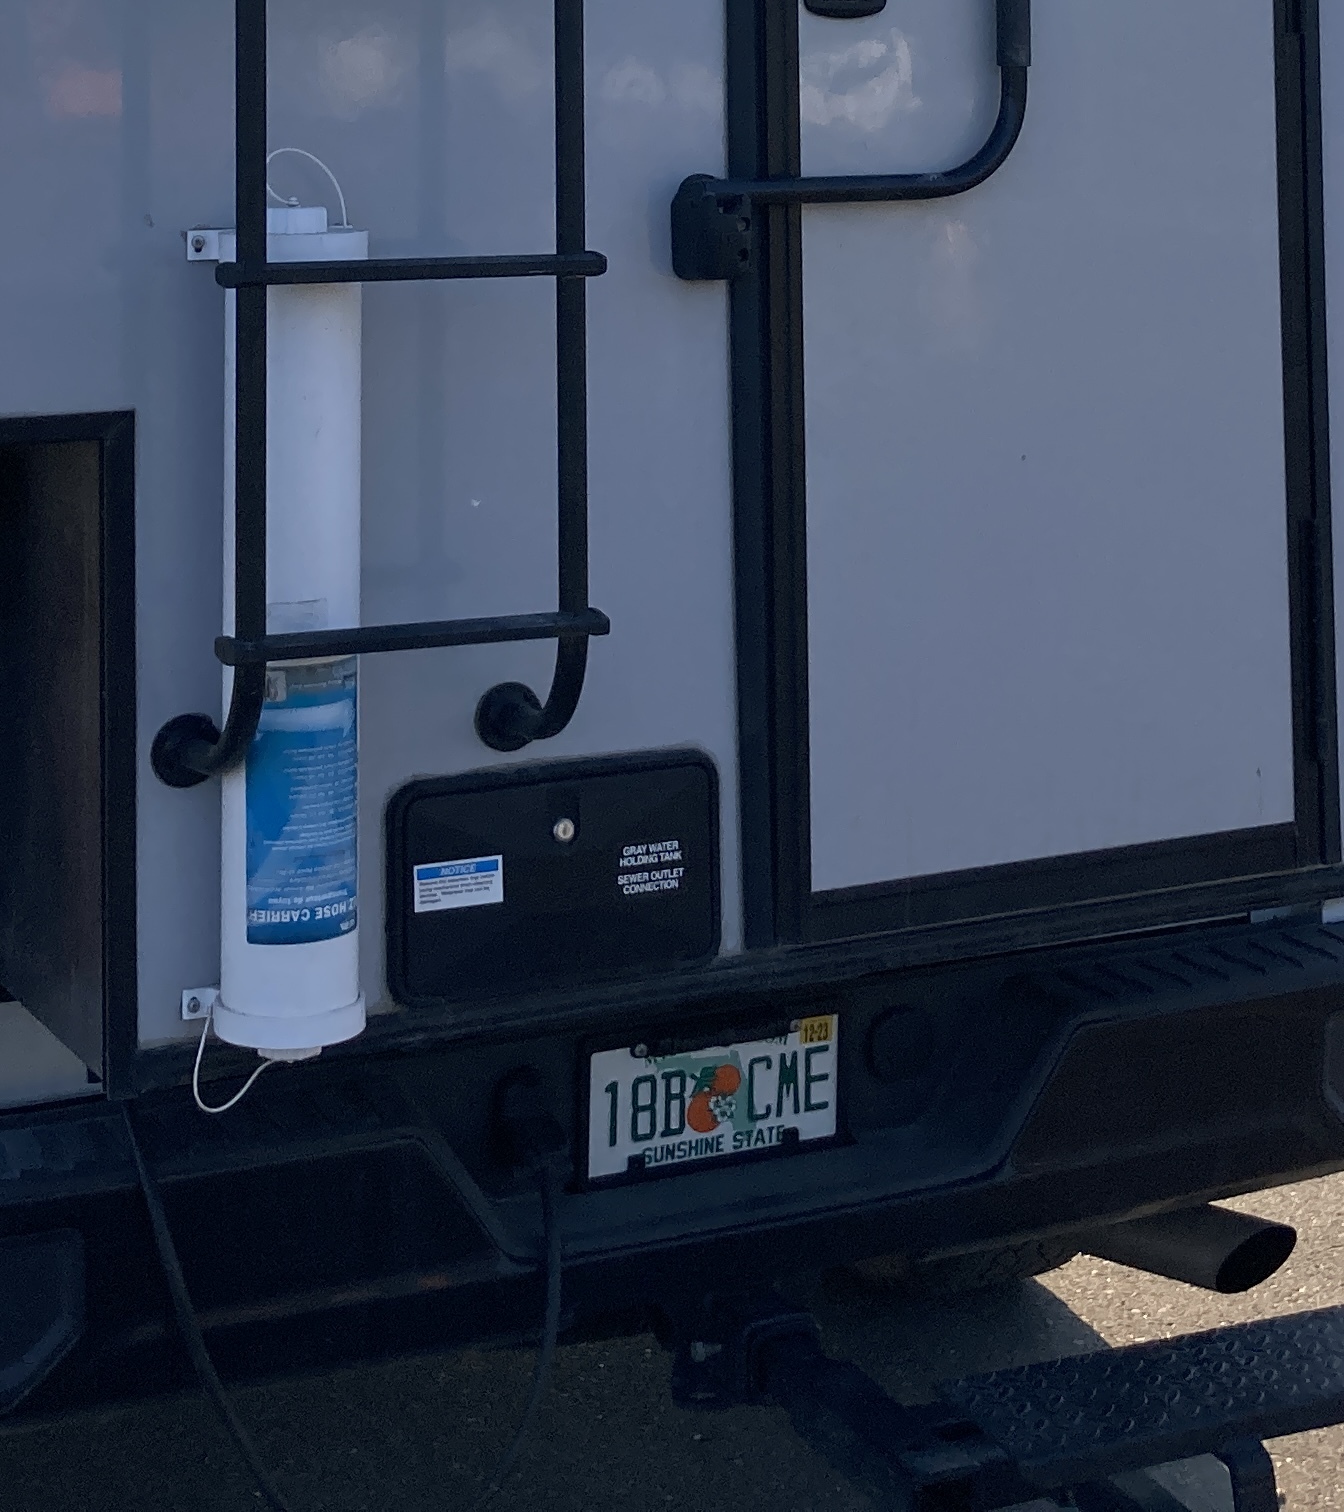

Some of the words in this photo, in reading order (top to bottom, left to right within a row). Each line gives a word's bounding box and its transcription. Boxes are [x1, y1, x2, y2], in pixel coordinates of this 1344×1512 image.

[622, 845, 647, 857] GRAY
[648, 840, 680, 853] WATER
[619, 853, 659, 868] HOLDING
[659, 850, 683, 863] TANK
[440, 863, 477, 876] NOTICE
[617, 871, 649, 886] SEWER
[650, 867, 685, 881] OUTLET
[622, 878, 680, 895] CONNECTION
[248, 908, 311, 923] CARRIER
[314, 900, 348, 920] HOSE
[802, 1022, 829, 1042] 12-23
[604, 1069, 687, 1148] 18B
[747, 1044, 830, 1123] CME
[641, 1133, 725, 1166] SUNSHINE
[732, 1123, 785, 1151] STATE
